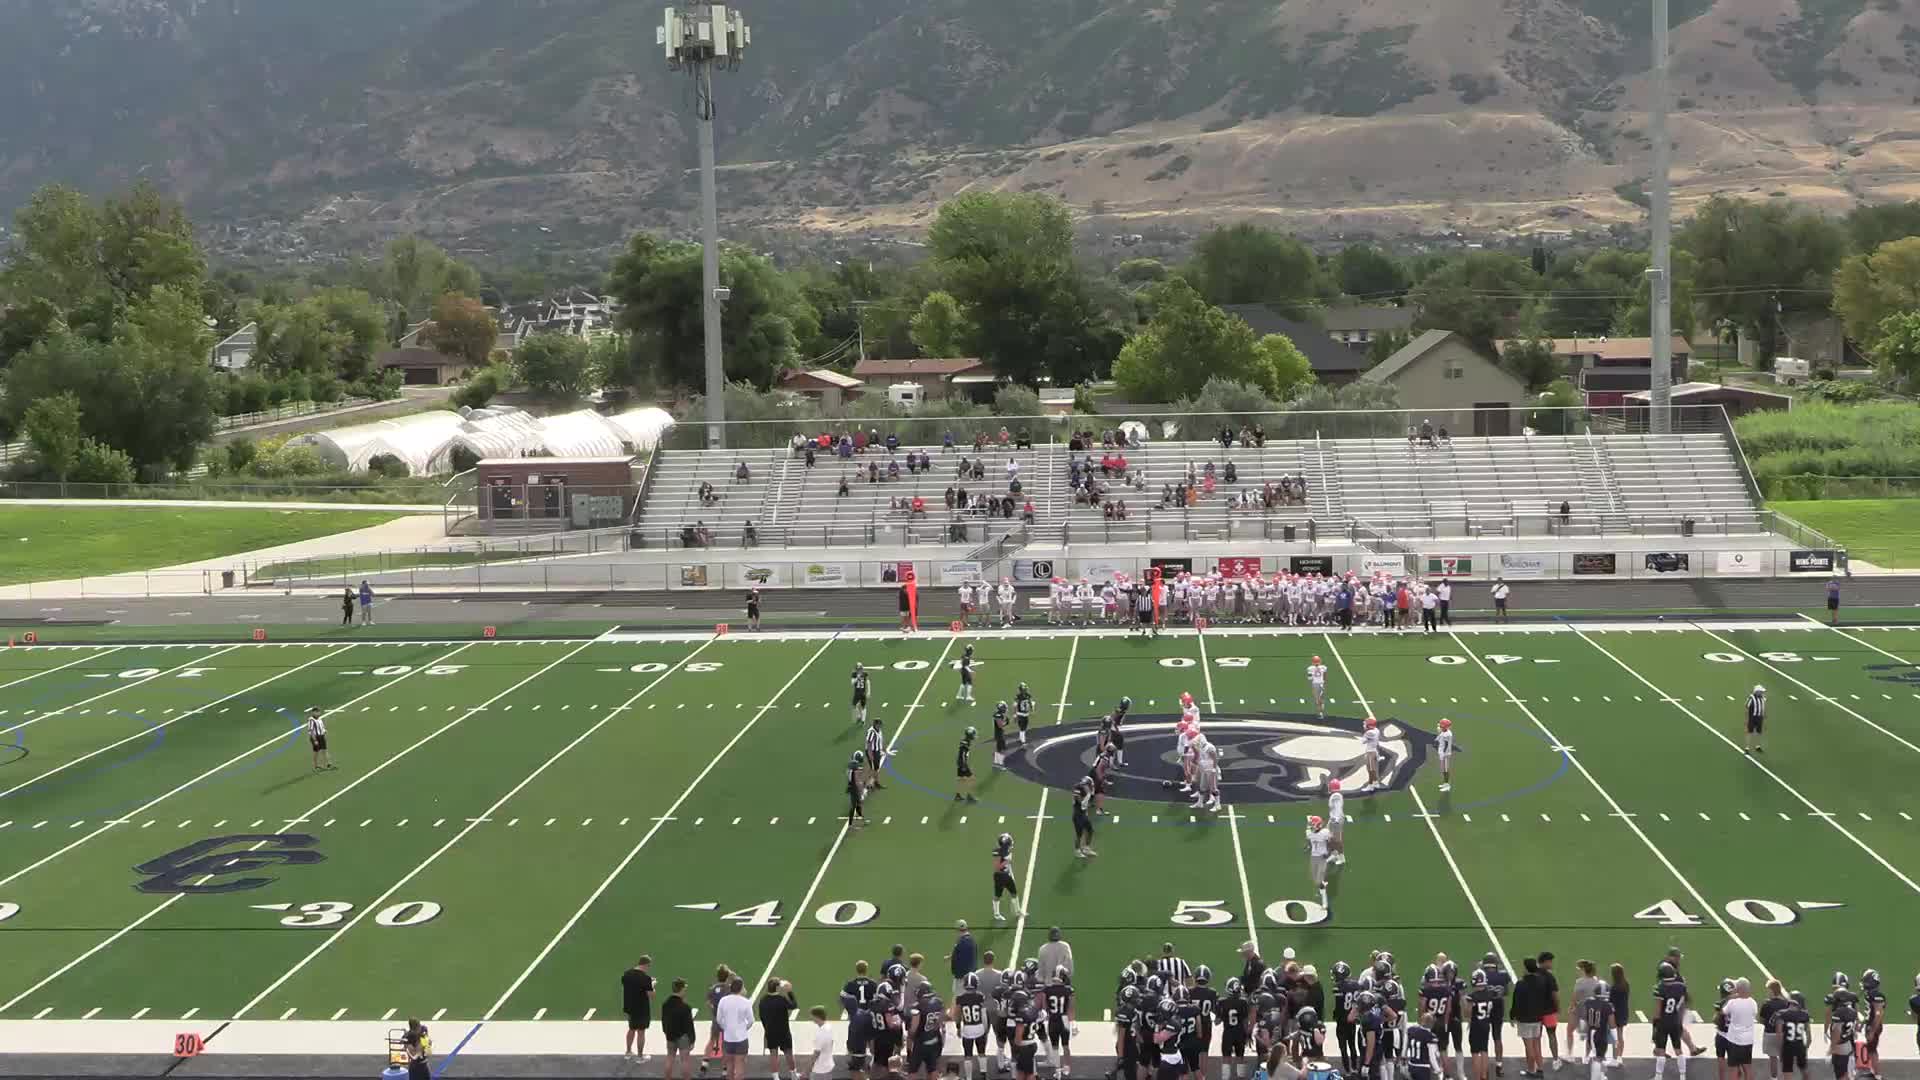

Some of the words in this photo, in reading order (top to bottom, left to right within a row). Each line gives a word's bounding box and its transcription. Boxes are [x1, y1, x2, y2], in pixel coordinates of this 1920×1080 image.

[24, 632, 34, 641] G
[280, 901, 442, 927] 30
[720, 901, 879, 926] 40
[1170, 900, 1328, 925] 50
[1633, 898, 1798, 926] 40
[857, 985, 867, 1004] 1
[962, 1005, 981, 1022] 86
[1048, 995, 1065, 1014] 31
[1428, 998, 1448, 1015] 96
[1227, 1009, 1238, 1026] 6
[175, 1035, 196, 1055] 30
